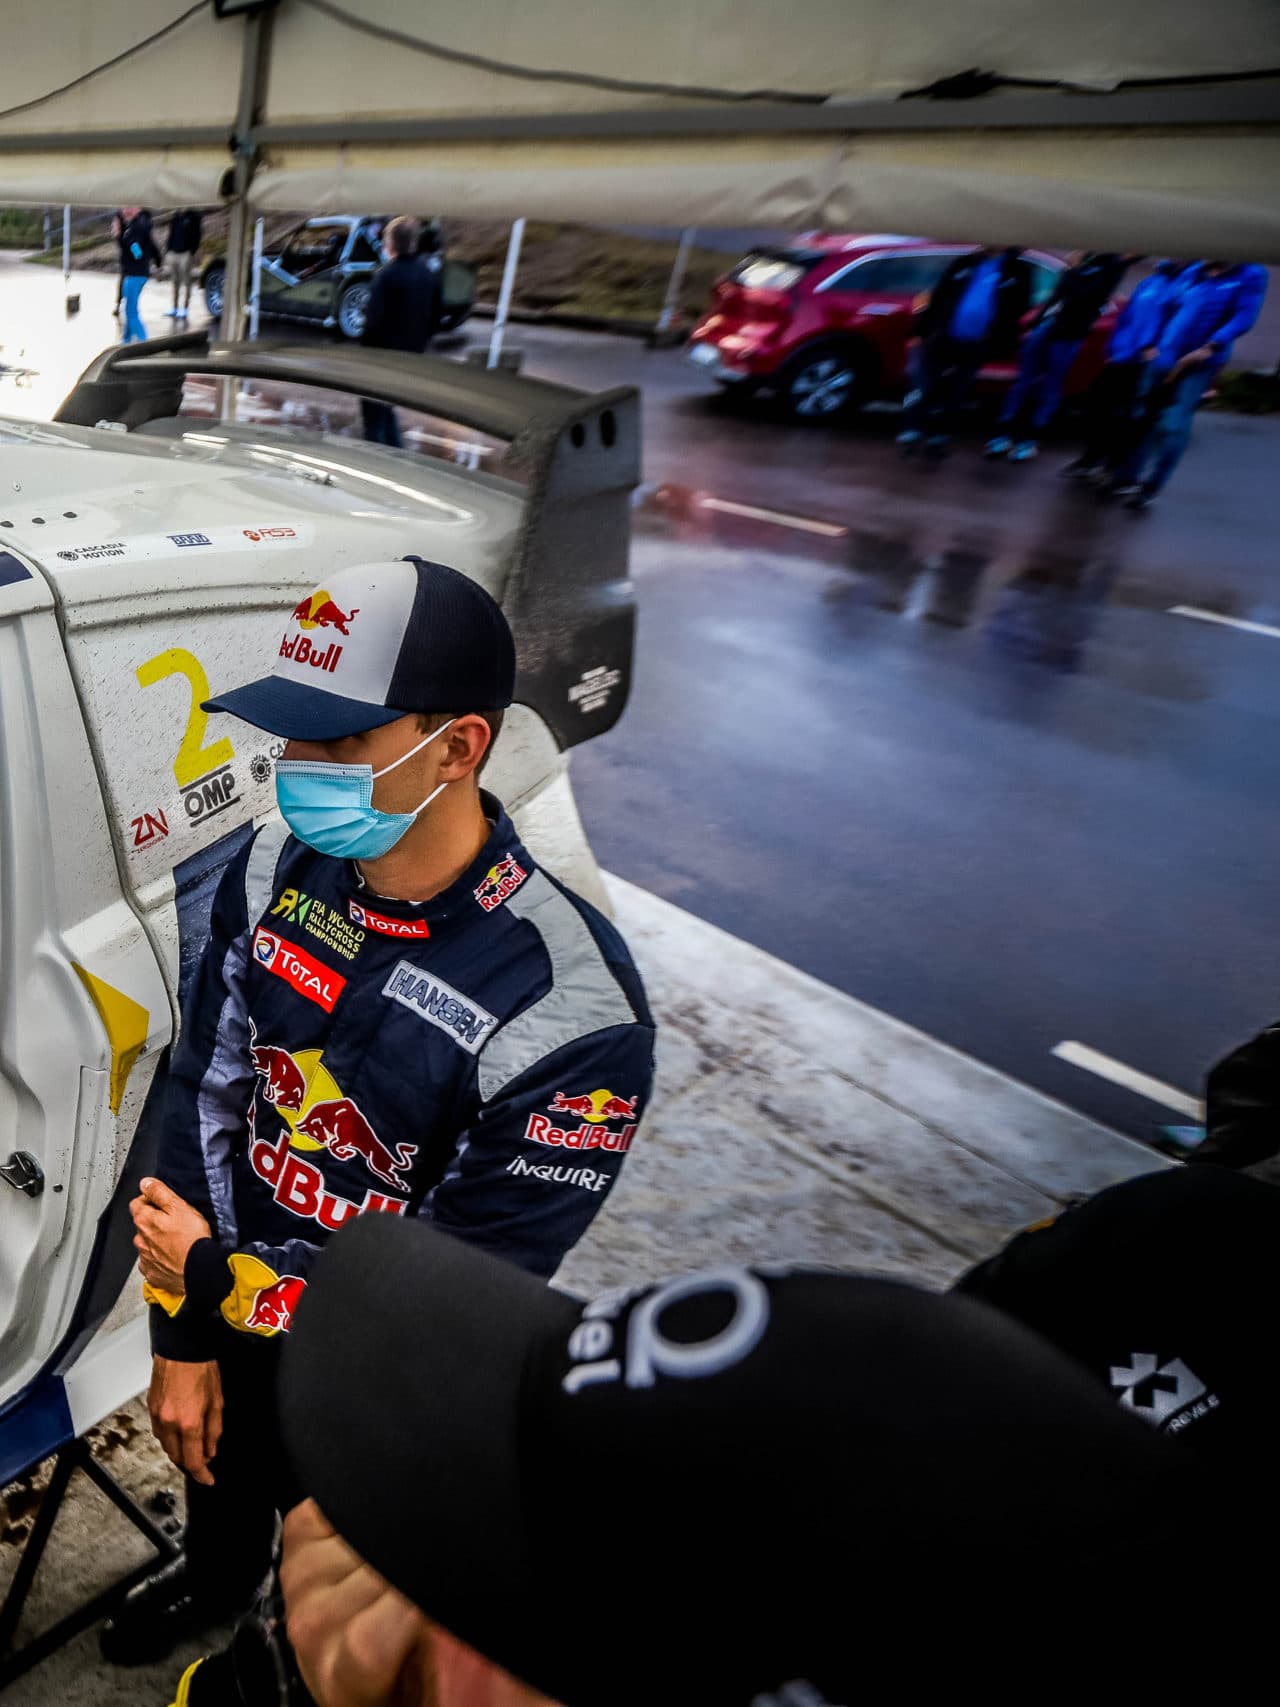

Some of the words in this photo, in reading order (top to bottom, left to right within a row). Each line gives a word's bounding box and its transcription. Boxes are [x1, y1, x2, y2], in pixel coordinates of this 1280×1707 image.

[75, 541, 128, 554] CASCADIA
[82, 549, 125, 560] MOTION
[294, 637, 343, 673] Bull
[135, 647, 235, 787] 2
[184, 772, 236, 818] OMP
[478, 882, 511, 912] Red
[500, 863, 528, 892] Bull
[304, 922, 356, 961] CHAMPIONSHIP
[308, 912, 361, 953] RALLYCROSS
[312, 900, 326, 917] FIA
[328, 909, 366, 943] WORLD
[366, 915, 425, 935] TOTAL
[280, 948, 334, 1003] TOTAL
[389, 967, 487, 1045] HANSEN
[524, 1112, 592, 1150] Red
[582, 1123, 639, 1153] Bull
